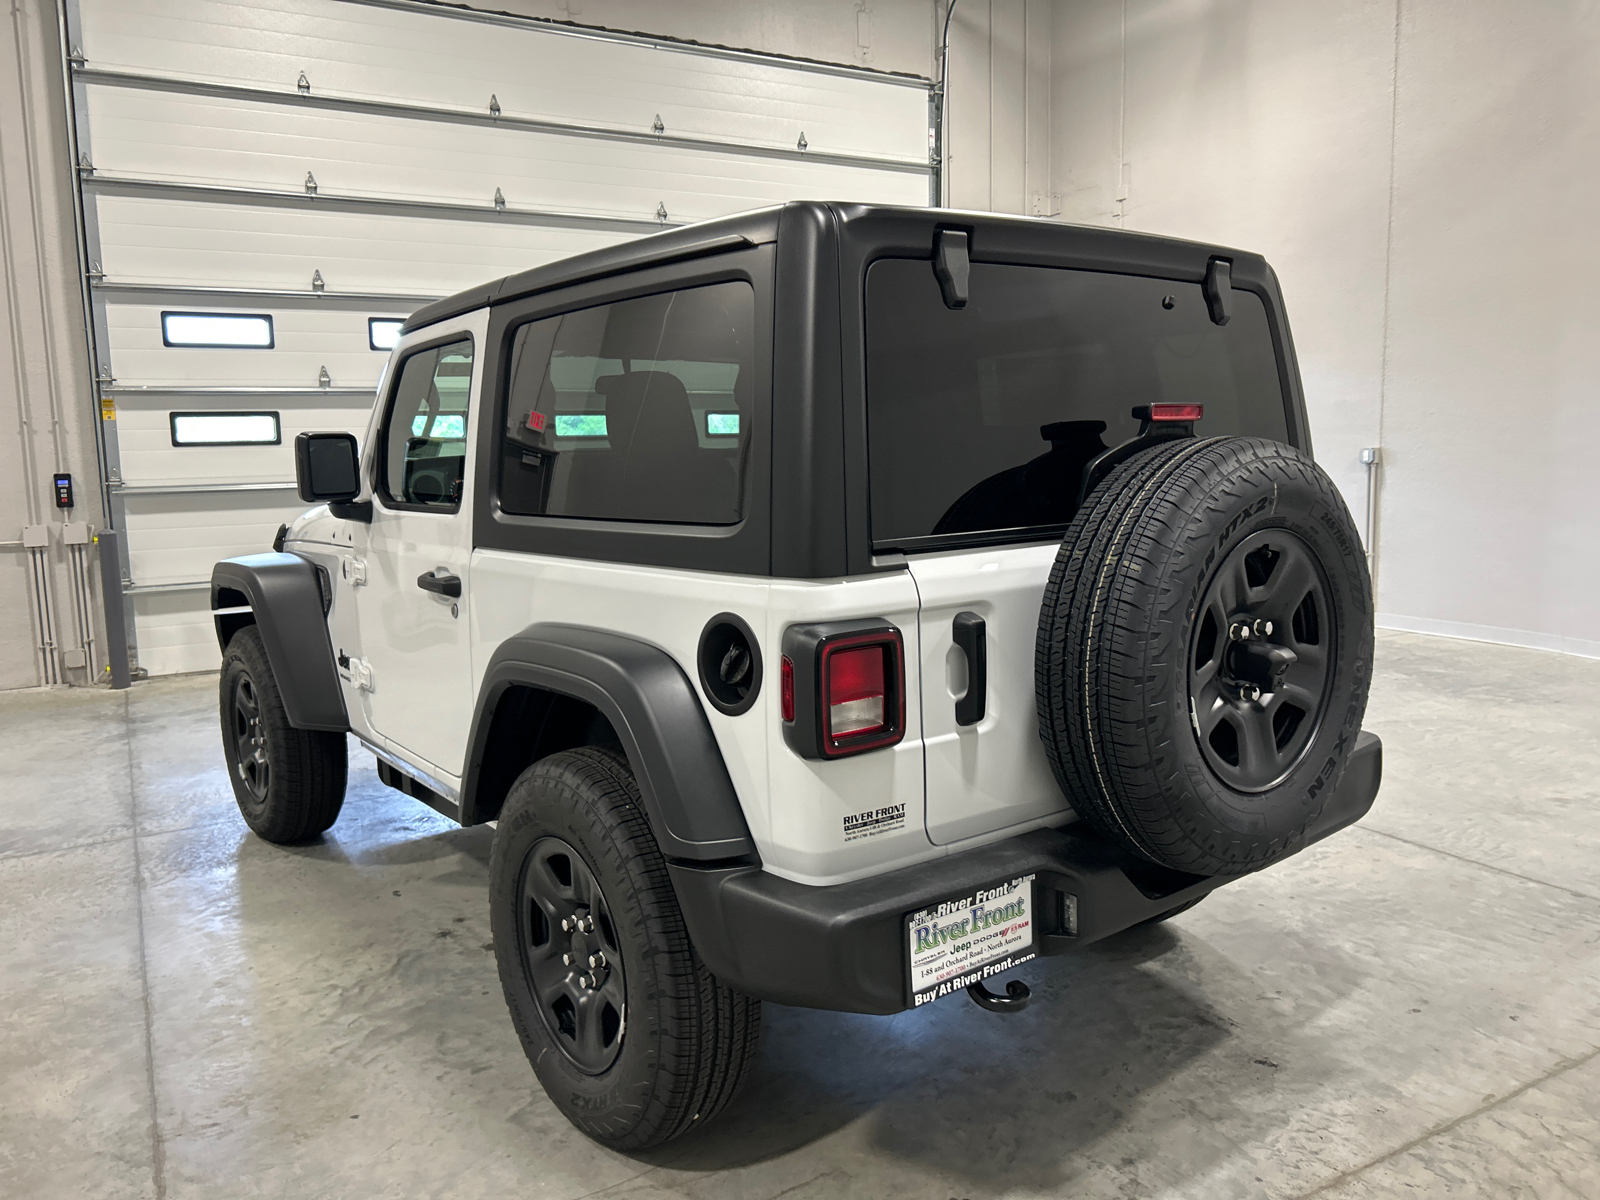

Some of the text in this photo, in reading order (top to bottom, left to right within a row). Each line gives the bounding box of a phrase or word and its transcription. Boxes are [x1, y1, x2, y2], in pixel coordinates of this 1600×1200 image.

[1218, 496, 1269, 551] HTX2
[1305, 676, 1363, 800] NEXEN
[843, 803, 906, 825] RIVER FRONT
[937, 883, 1009, 916] River Front
[914, 917, 970, 954] River
[969, 896, 1025, 934] Front
[1017, 920, 1029, 930] RAM
[921, 935, 1022, 978] I-88 and Orchard Road North Aurora
[950, 941, 972, 955] Jeep
[914, 952, 1036, 1006] Buy At River Front.com
